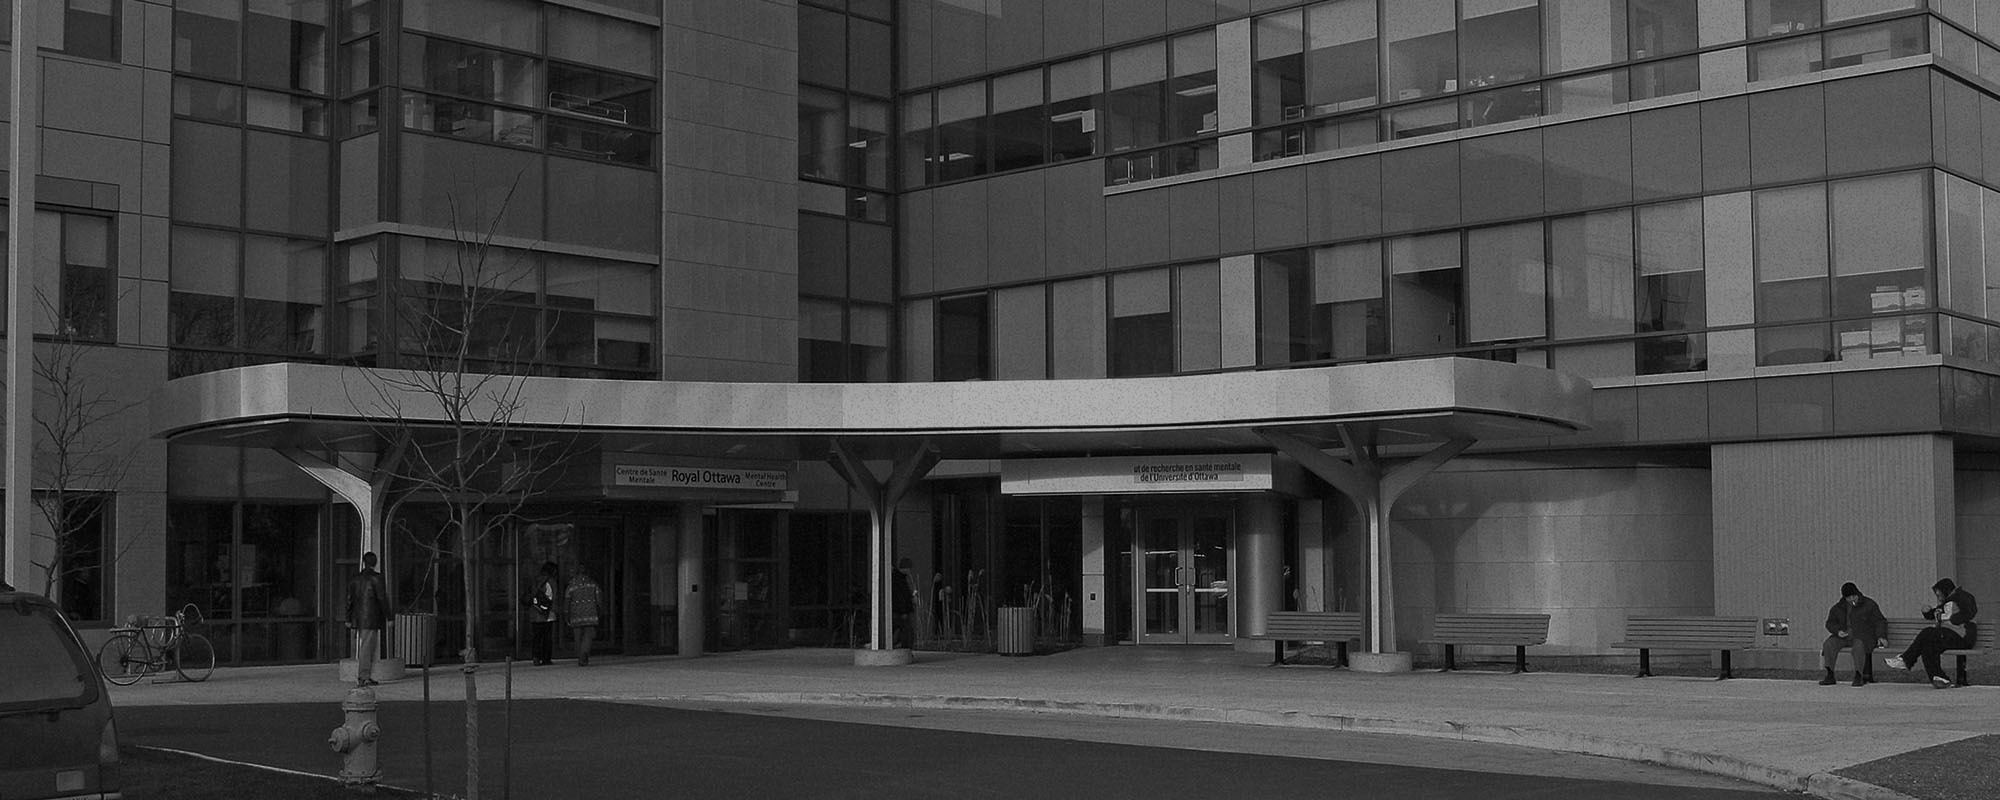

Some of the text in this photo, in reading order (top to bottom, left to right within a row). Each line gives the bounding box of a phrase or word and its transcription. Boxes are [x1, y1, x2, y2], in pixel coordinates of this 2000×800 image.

[640, 468, 648, 476] de
[1141, 464, 1150, 472] de
[1184, 464, 1193, 472] en
[1214, 462, 1240, 471] mentale
[672, 469, 741, 485] Royal Ottawa
[1140, 472, 1149, 482] de
